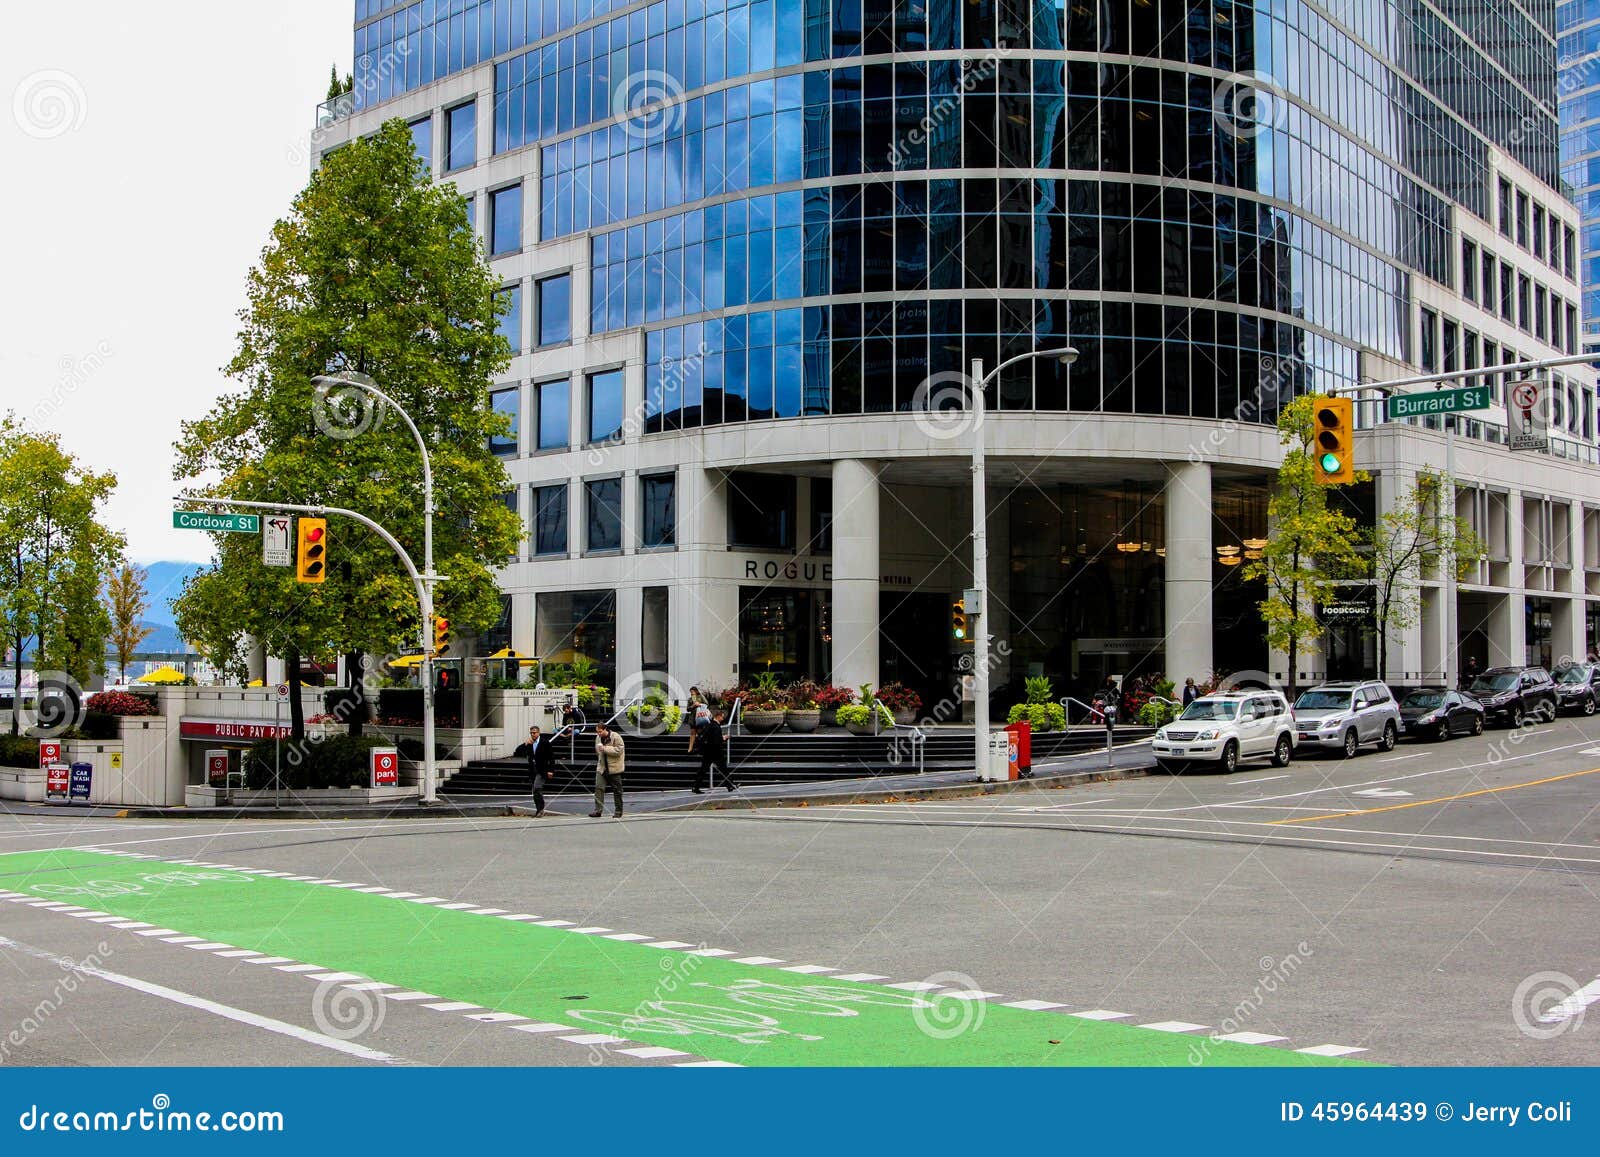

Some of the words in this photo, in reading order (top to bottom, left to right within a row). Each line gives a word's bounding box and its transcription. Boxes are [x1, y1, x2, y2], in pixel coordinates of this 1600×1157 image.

[1397, 394, 1455, 414] Burrard
[1463, 391, 1481, 407] St
[180, 514, 233, 529] Cordova
[239, 517, 252, 529] St
[745, 560, 832, 581] ROGUE
[215, 724, 245, 737] PUBLIC
[249, 726, 265, 738] PAY
[376, 769, 396, 780] park
